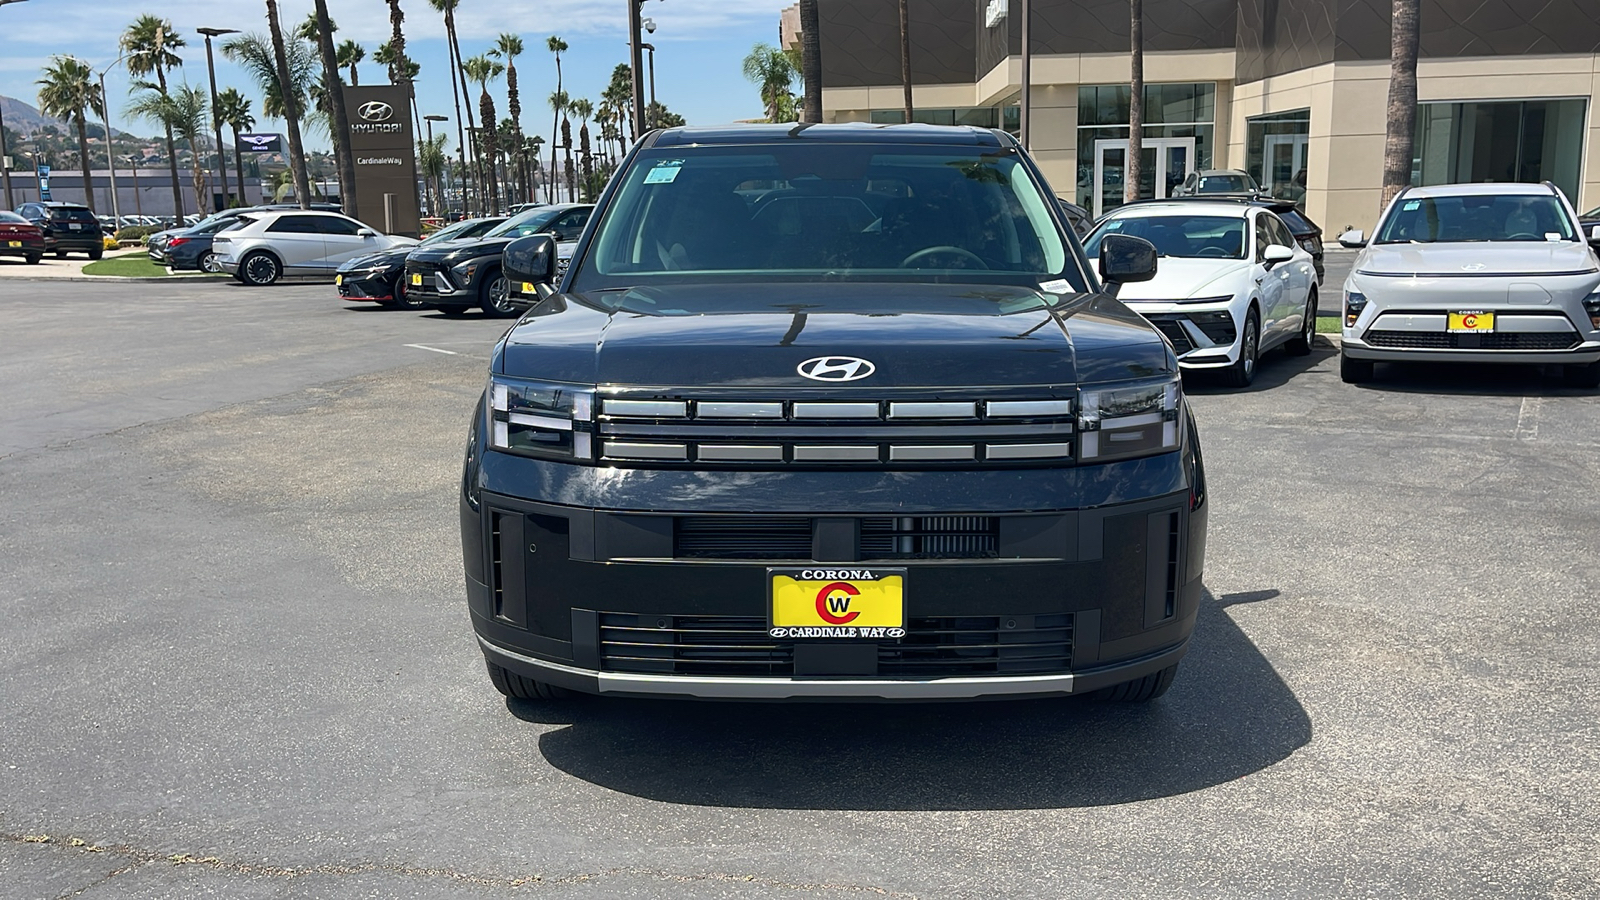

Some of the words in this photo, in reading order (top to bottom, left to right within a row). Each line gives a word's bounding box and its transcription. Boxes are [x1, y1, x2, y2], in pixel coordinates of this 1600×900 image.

[351, 123, 402, 133] HYUNDAI
[357, 157, 402, 165] CardinaleWay
[801, 570, 874, 580] CORONA
[789, 627, 857, 638] CARDINALE
[860, 627, 887, 638] WAY
